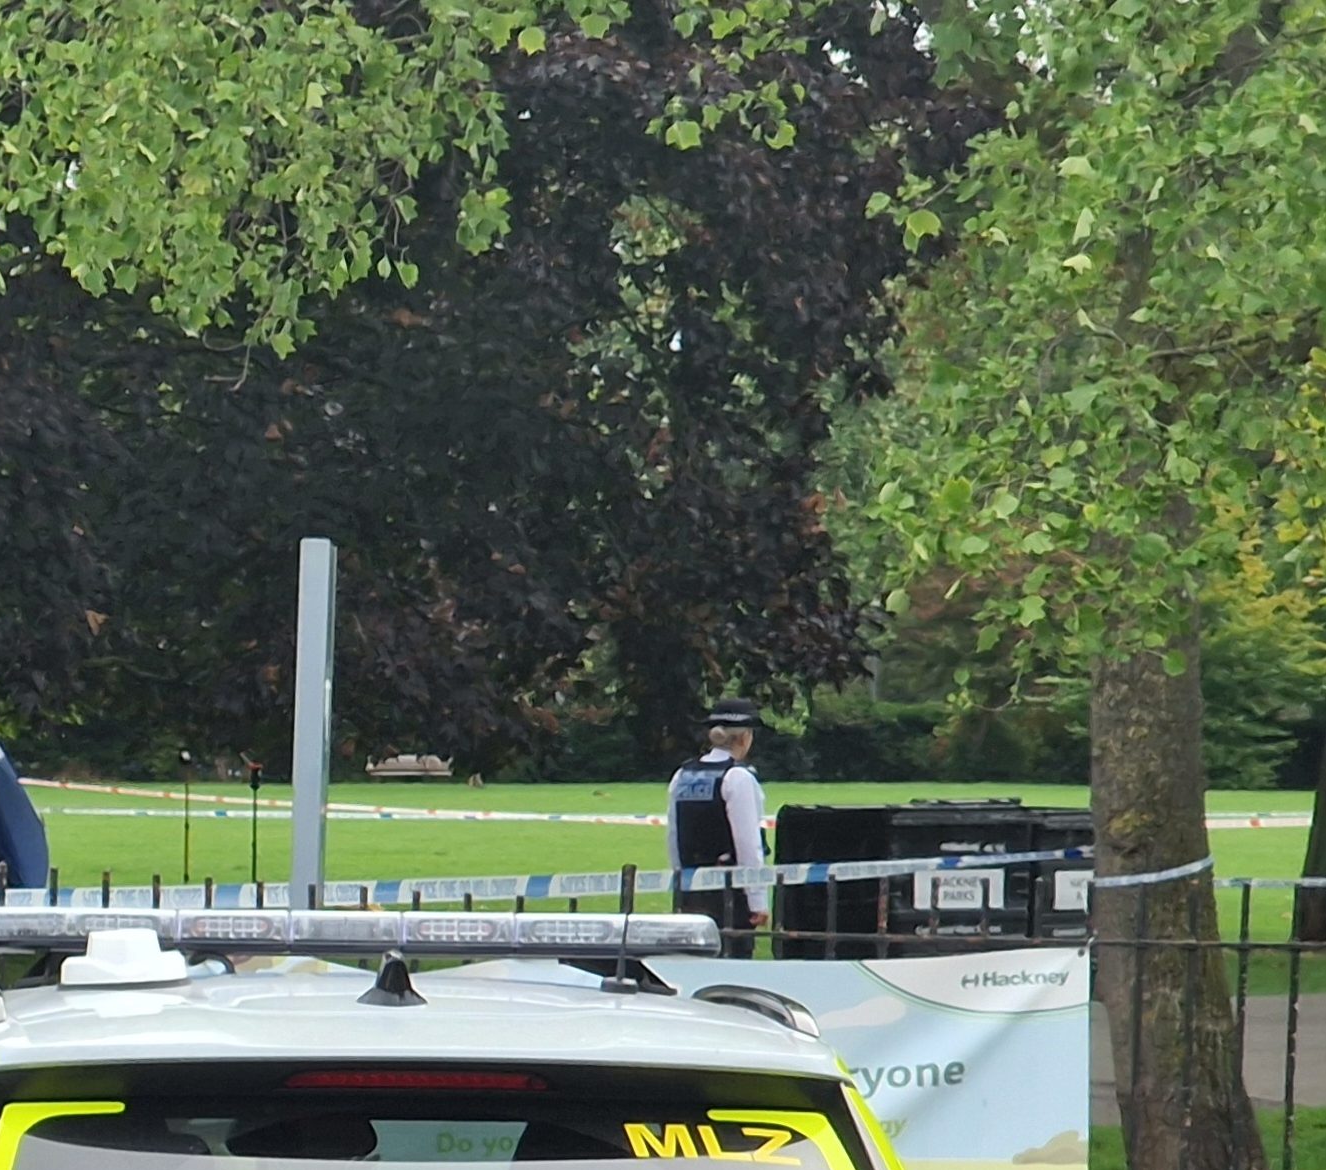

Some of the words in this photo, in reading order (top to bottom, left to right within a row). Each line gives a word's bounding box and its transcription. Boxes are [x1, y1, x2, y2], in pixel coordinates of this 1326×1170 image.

[938, 875, 984, 888] ACKNE
[942, 888, 976, 901] PARKS
[982, 969, 1070, 987] Hackney
[435, 1132, 475, 1153] Do
[622, 1122, 802, 1166] MLZ
